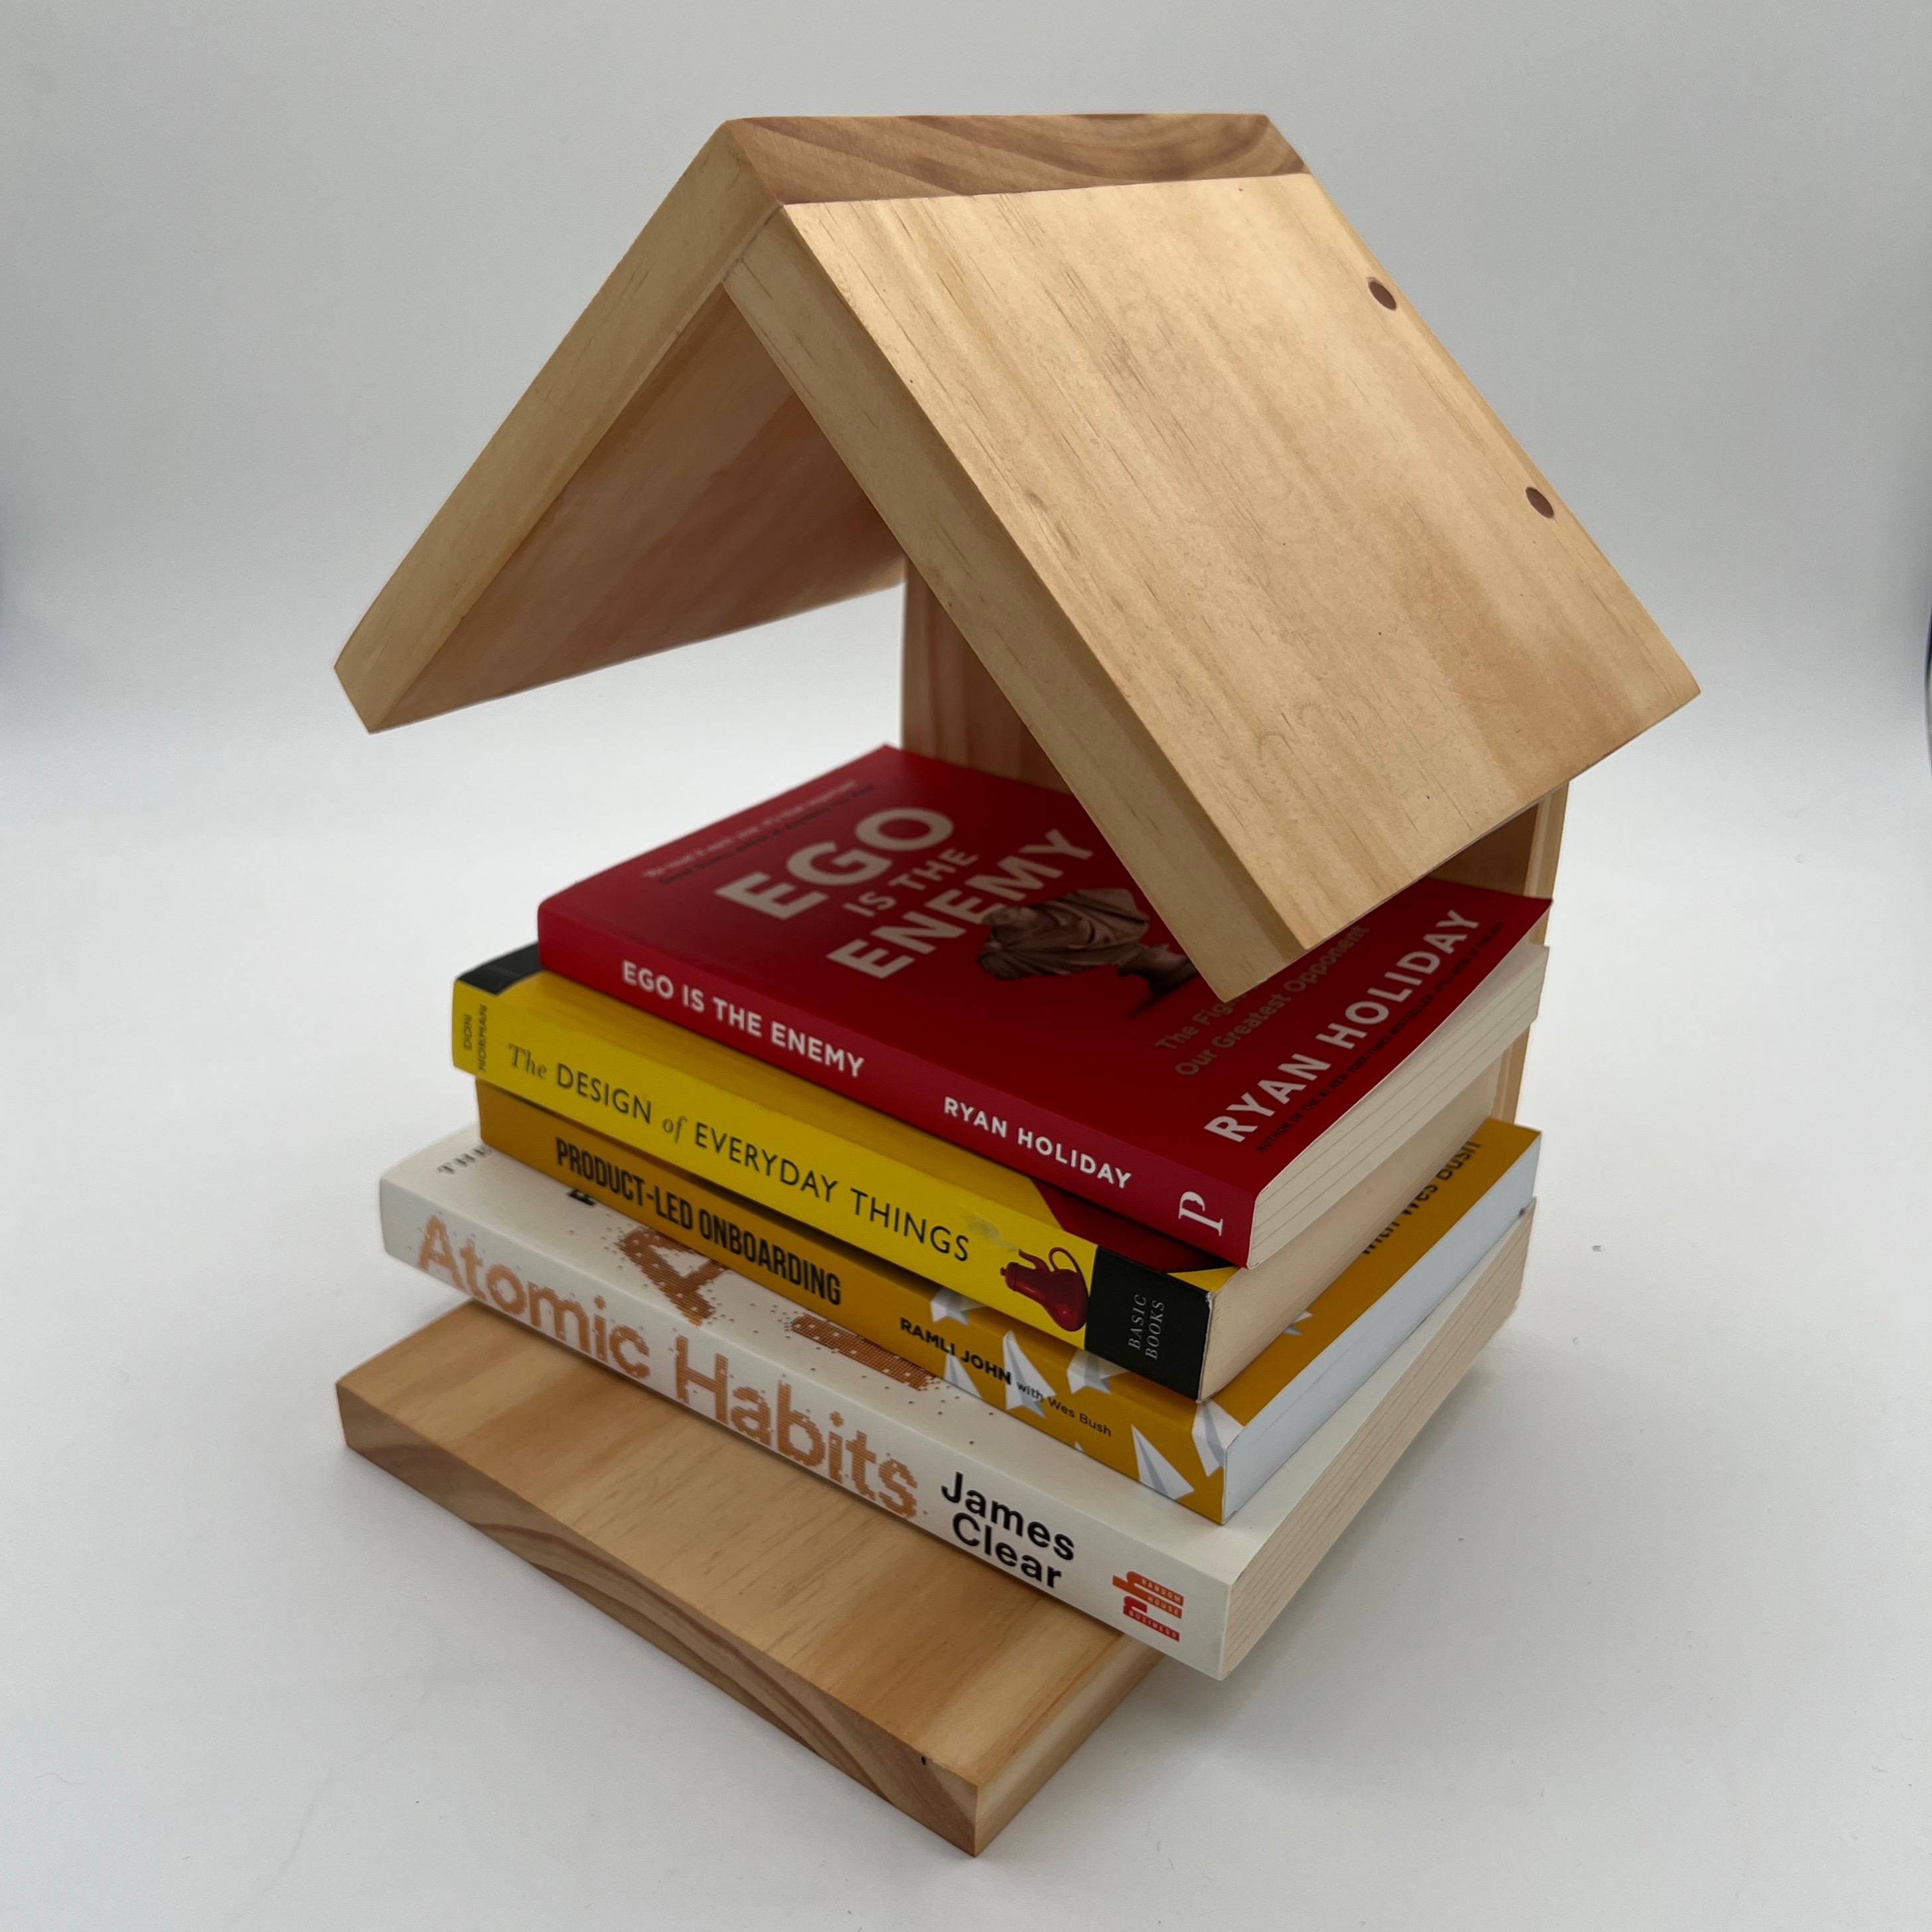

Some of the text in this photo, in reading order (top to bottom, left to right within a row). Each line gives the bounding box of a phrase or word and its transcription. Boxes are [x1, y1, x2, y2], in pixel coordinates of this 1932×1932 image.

[714, 807, 954, 921] EGO
[826, 828, 1094, 980] ENEMY
[843, 848, 980, 918] IS THE
[463, 1013, 473, 1051] DON
[478, 1003, 488, 1073] NORMAN
[622, 960, 864, 1079] EGO IS THE ENEMY
[1154, 1025, 1199, 1050] The
[1175, 1049, 1217, 1076] Our
[1212, 994, 1292, 1049] Greatest
[1284, 925, 1370, 992] Opponent
[1203, 1053, 1332, 1143] RYAN
[1315, 909, 1479, 1050] HOLIDAY
[508, 1043, 969, 1262] The DESIGN of EVERYDAY THINGS
[943, 1096, 1132, 1190] RYAN HOLIDAY
[556, 1136, 694, 1232] PRODUCT-LED
[699, 1208, 842, 1306] ONBOARDING
[417, 1214, 651, 1380] Atomic
[674, 1335, 919, 1520] Habits
[1128, 1294, 1147, 1351] BASIC
[1145, 1300, 1165, 1361] BOOKS
[900, 1317, 1112, 1437] RAMLI JOHN with Wes Bush
[940, 1471, 1075, 1561] James
[952, 1512, 1062, 1589] Clear
[1129, 1609, 1177, 1639] BUSINESS
[1142, 1578, 1181, 1600] RANDOM
[1148, 1595, 1179, 1615] HOUSE
